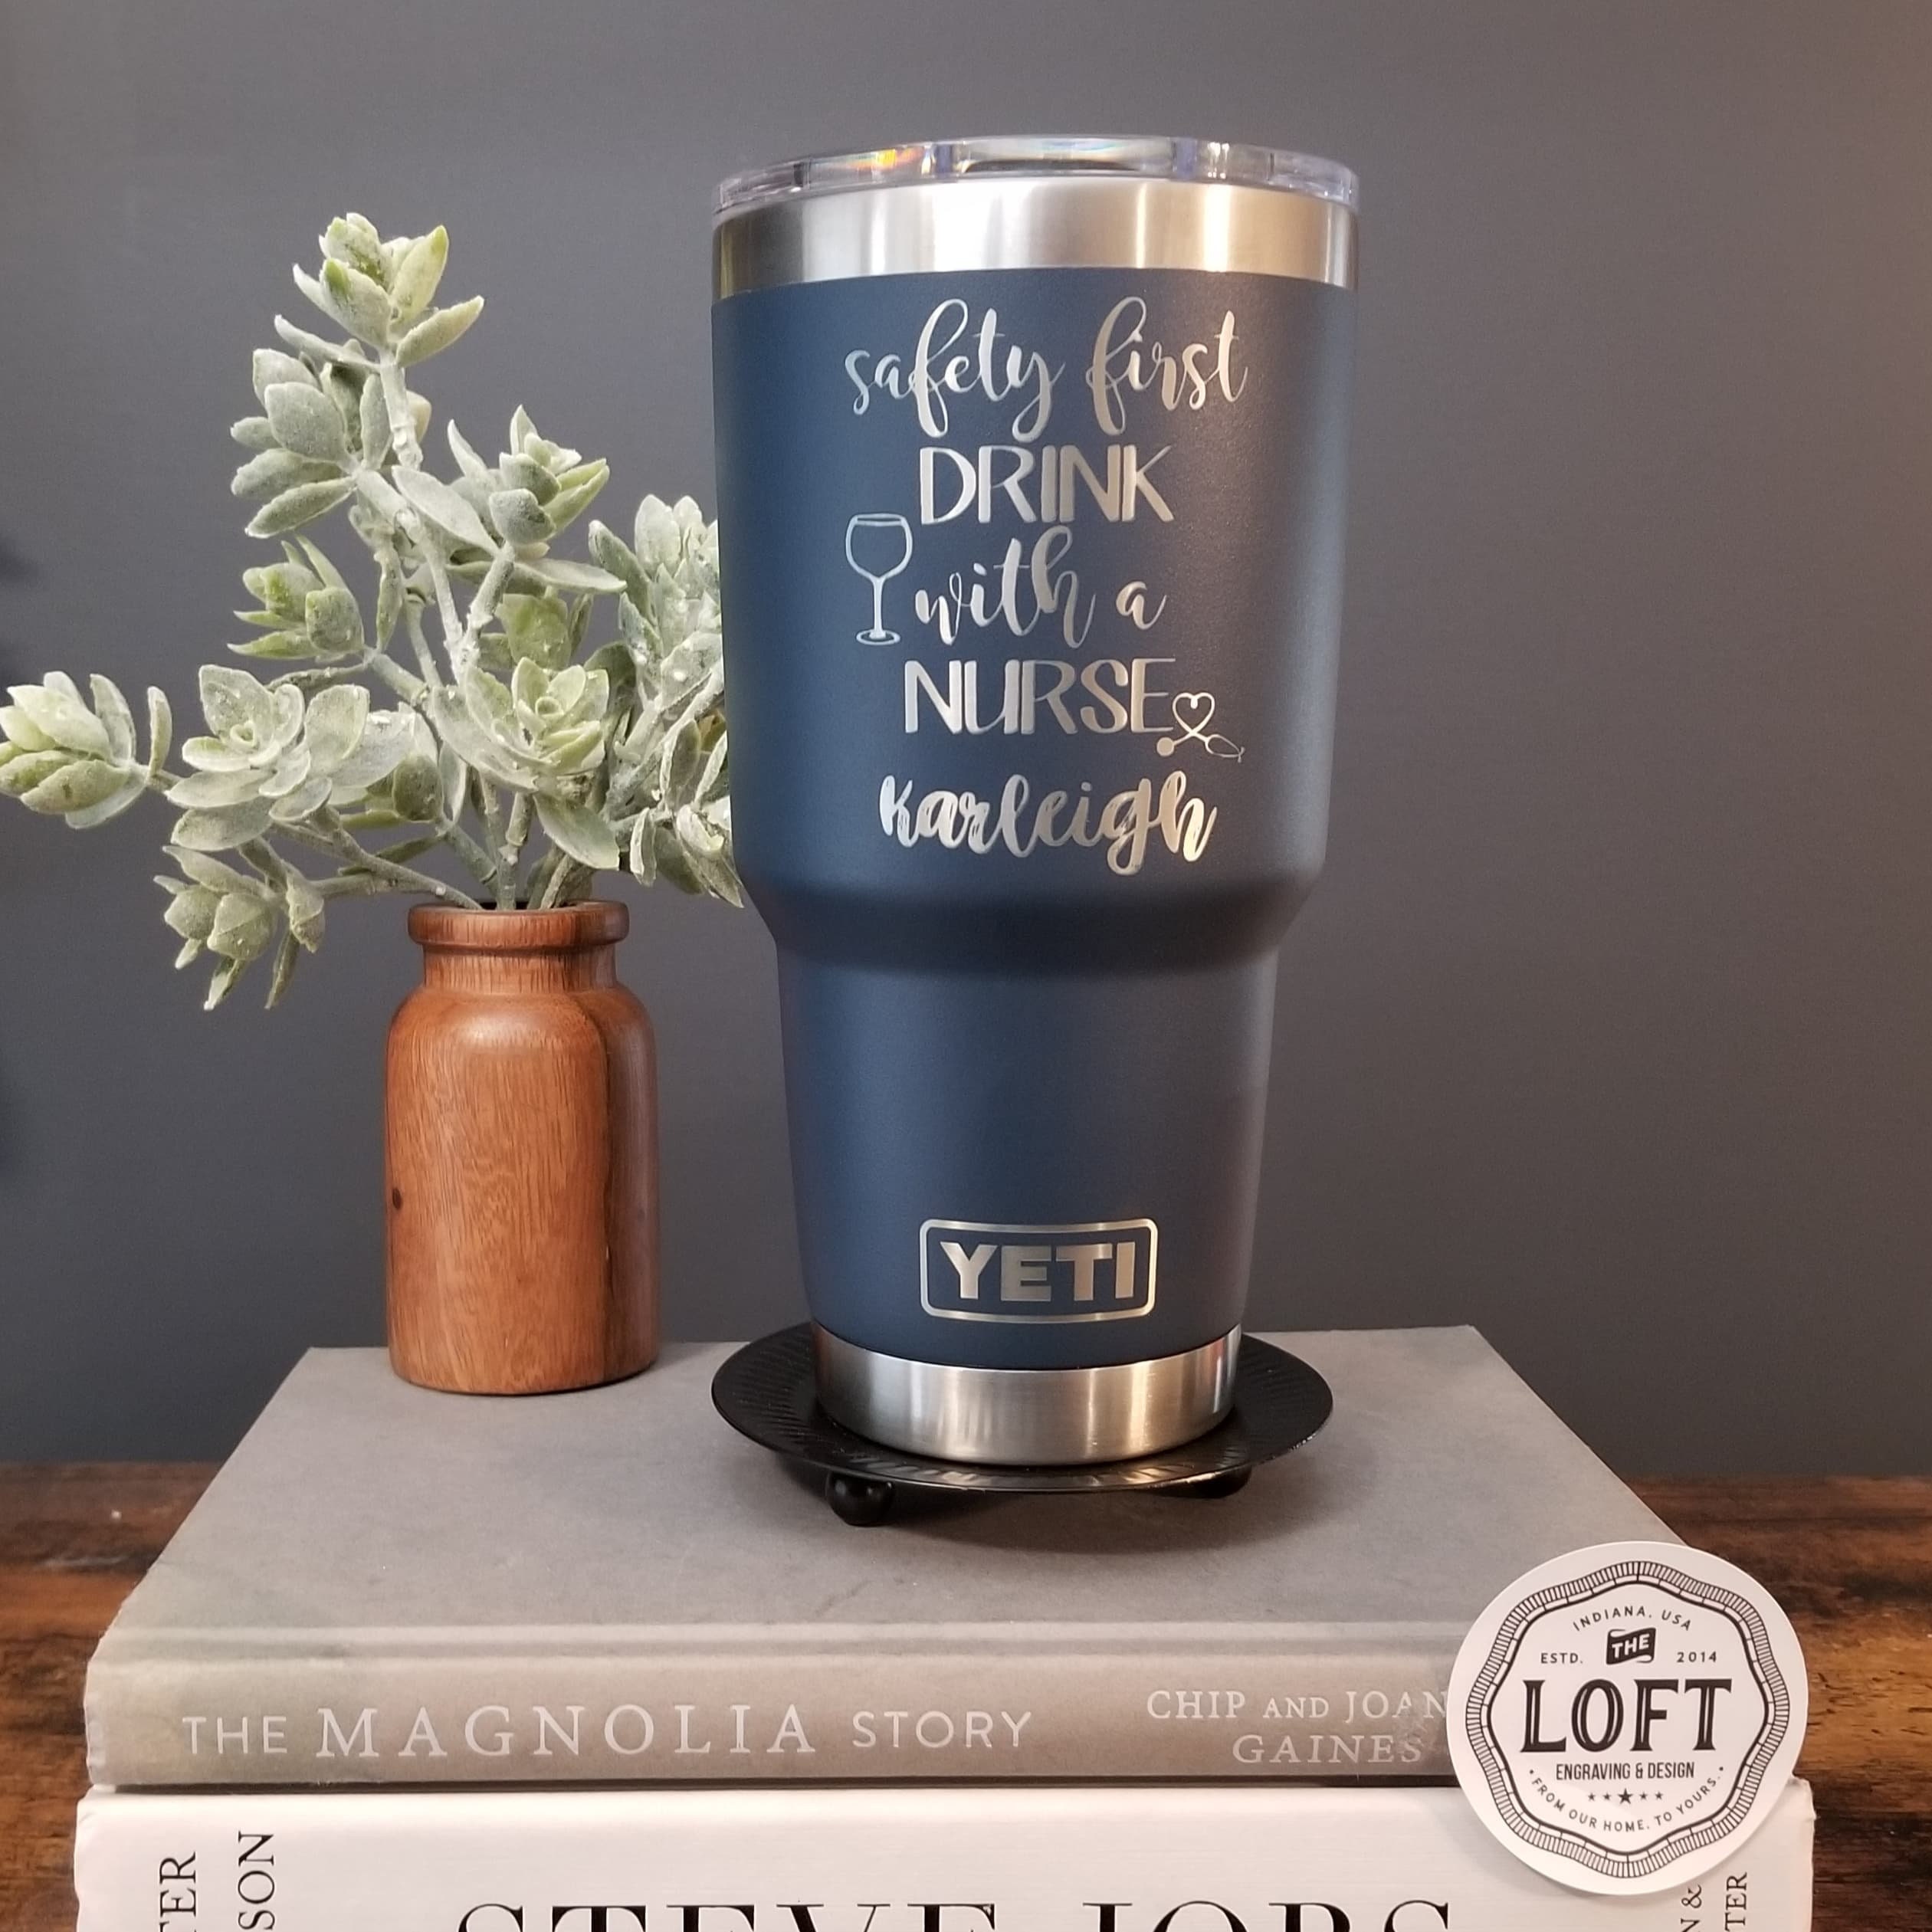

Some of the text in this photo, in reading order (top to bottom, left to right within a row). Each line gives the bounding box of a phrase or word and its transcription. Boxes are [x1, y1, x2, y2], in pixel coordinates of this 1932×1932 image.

[845, 297, 1248, 442] safety first
[920, 444, 1174, 524] DRINK
[915, 526, 1167, 648] with a
[904, 658, 1176, 734] NURSE
[940, 1241, 1136, 1301] YETI
[1612, 1633, 1650, 1658] THE
[1661, 1609, 1691, 1631] USA
[1540, 1652, 1717, 1664] ESTD. 2014
[182, 1704, 1032, 1758] THE MAGNOLIA STORY
[1147, 1691, 1245, 1719] CHIP
[1263, 1697, 1330, 1719] AND
[1520, 1678, 1732, 1753] LOFT
[1232, 1734, 1422, 1763] GAINES
[1556, 1762, 1695, 1780] ENGRAVING & DESIGN
[1532, 1777, 1566, 1812] FROM
[1569, 1809, 1598, 1829] OUR
[1654, 1811, 1672, 1826] TO
[1681, 1884, 1702, 1909] &
